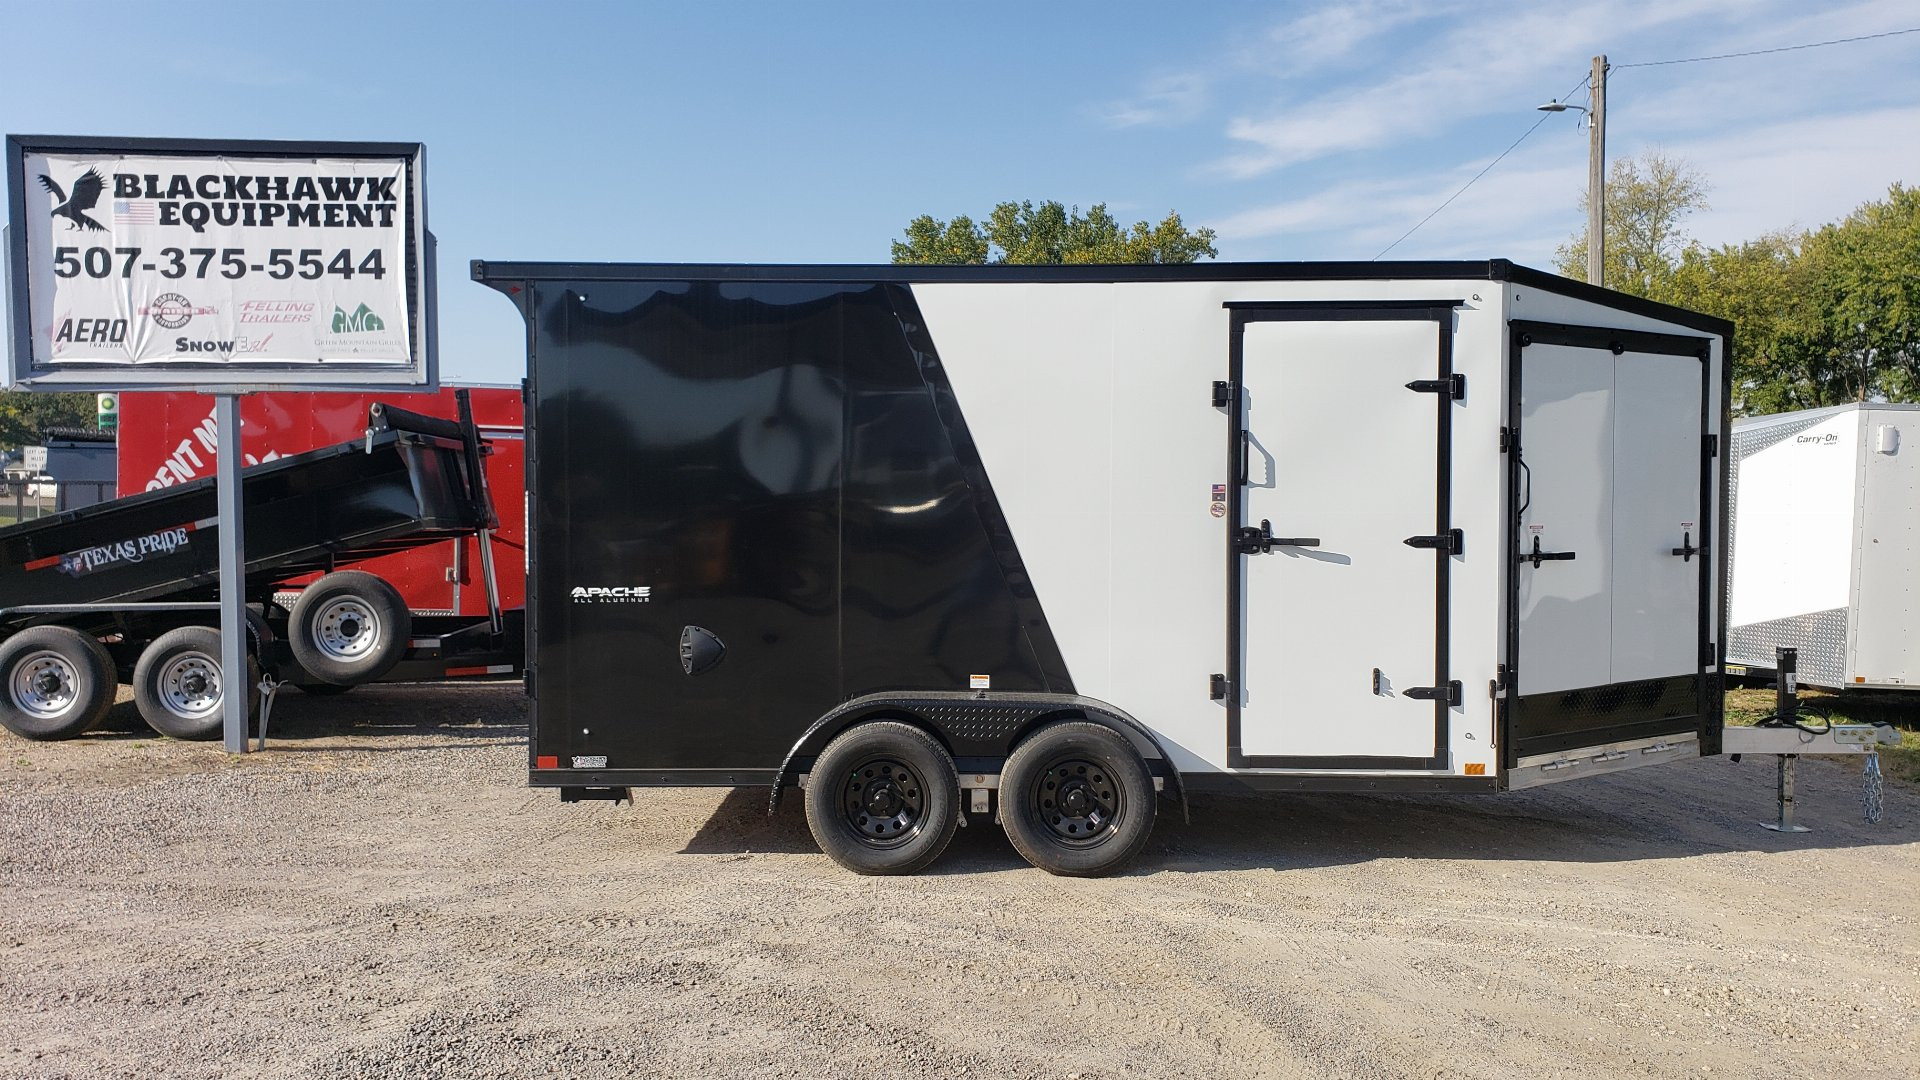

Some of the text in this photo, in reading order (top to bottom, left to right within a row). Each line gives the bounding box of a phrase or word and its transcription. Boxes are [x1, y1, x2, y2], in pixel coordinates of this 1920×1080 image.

[113, 173, 397, 201] BLACKHAWK
[159, 201, 397, 233] EQUIPMENT
[54, 247, 386, 280] 507-375-5544
[240, 300, 315, 312] FELLING
[240, 312, 312, 323] TRAILERS
[56, 318, 129, 343] AERO
[331, 311, 382, 334] GMG
[1797, 434, 1838, 444] Carry-On
[80, 527, 189, 571] TEXAS PRIDE
[569, 586, 651, 597] APACHE
